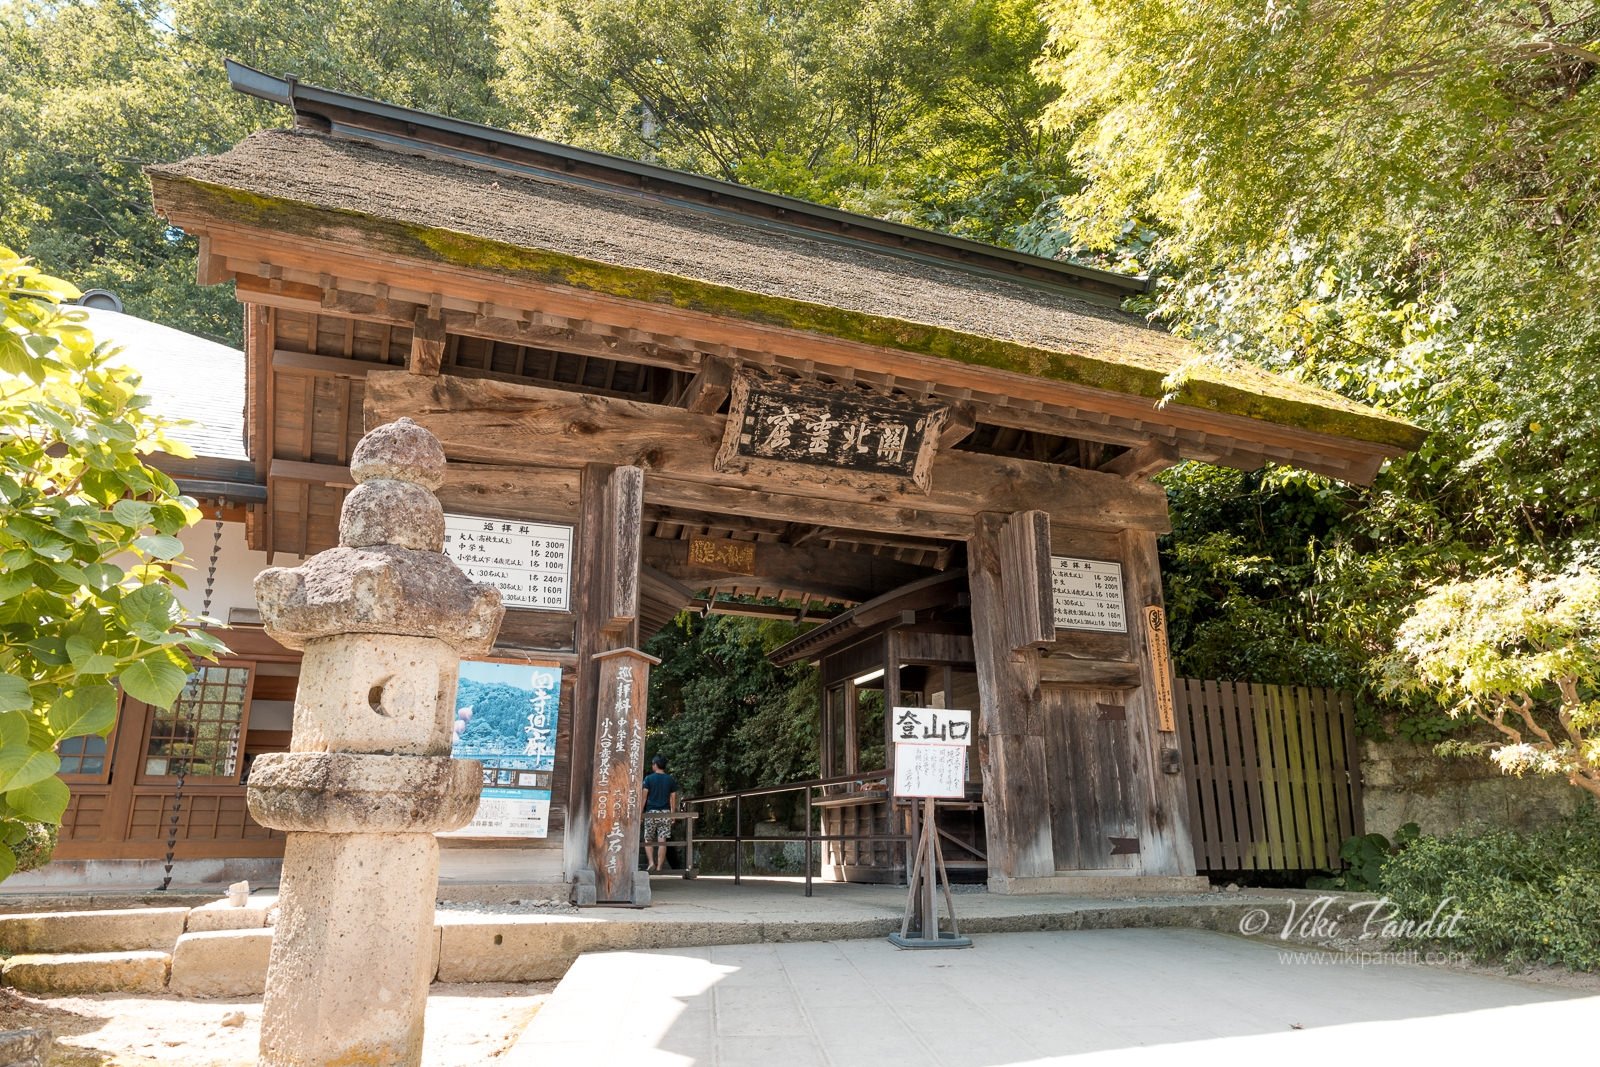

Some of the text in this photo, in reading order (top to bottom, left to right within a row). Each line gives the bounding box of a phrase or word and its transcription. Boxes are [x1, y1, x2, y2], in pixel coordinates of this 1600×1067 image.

[531, 540, 541, 548] 1名
[545, 541, 565, 549] 300円
[459, 543, 486, 552] 中学生
[545, 551, 564, 559] 200円
[545, 561, 564, 569] 100円
[543, 575, 563, 583] 240円
[543, 586, 562, 594] 160円
[543, 596, 562, 604] 100円
[615, 666, 634, 715] 巡拝料
[896, 710, 970, 742] 登山口
[615, 717, 628, 752] 中学生
